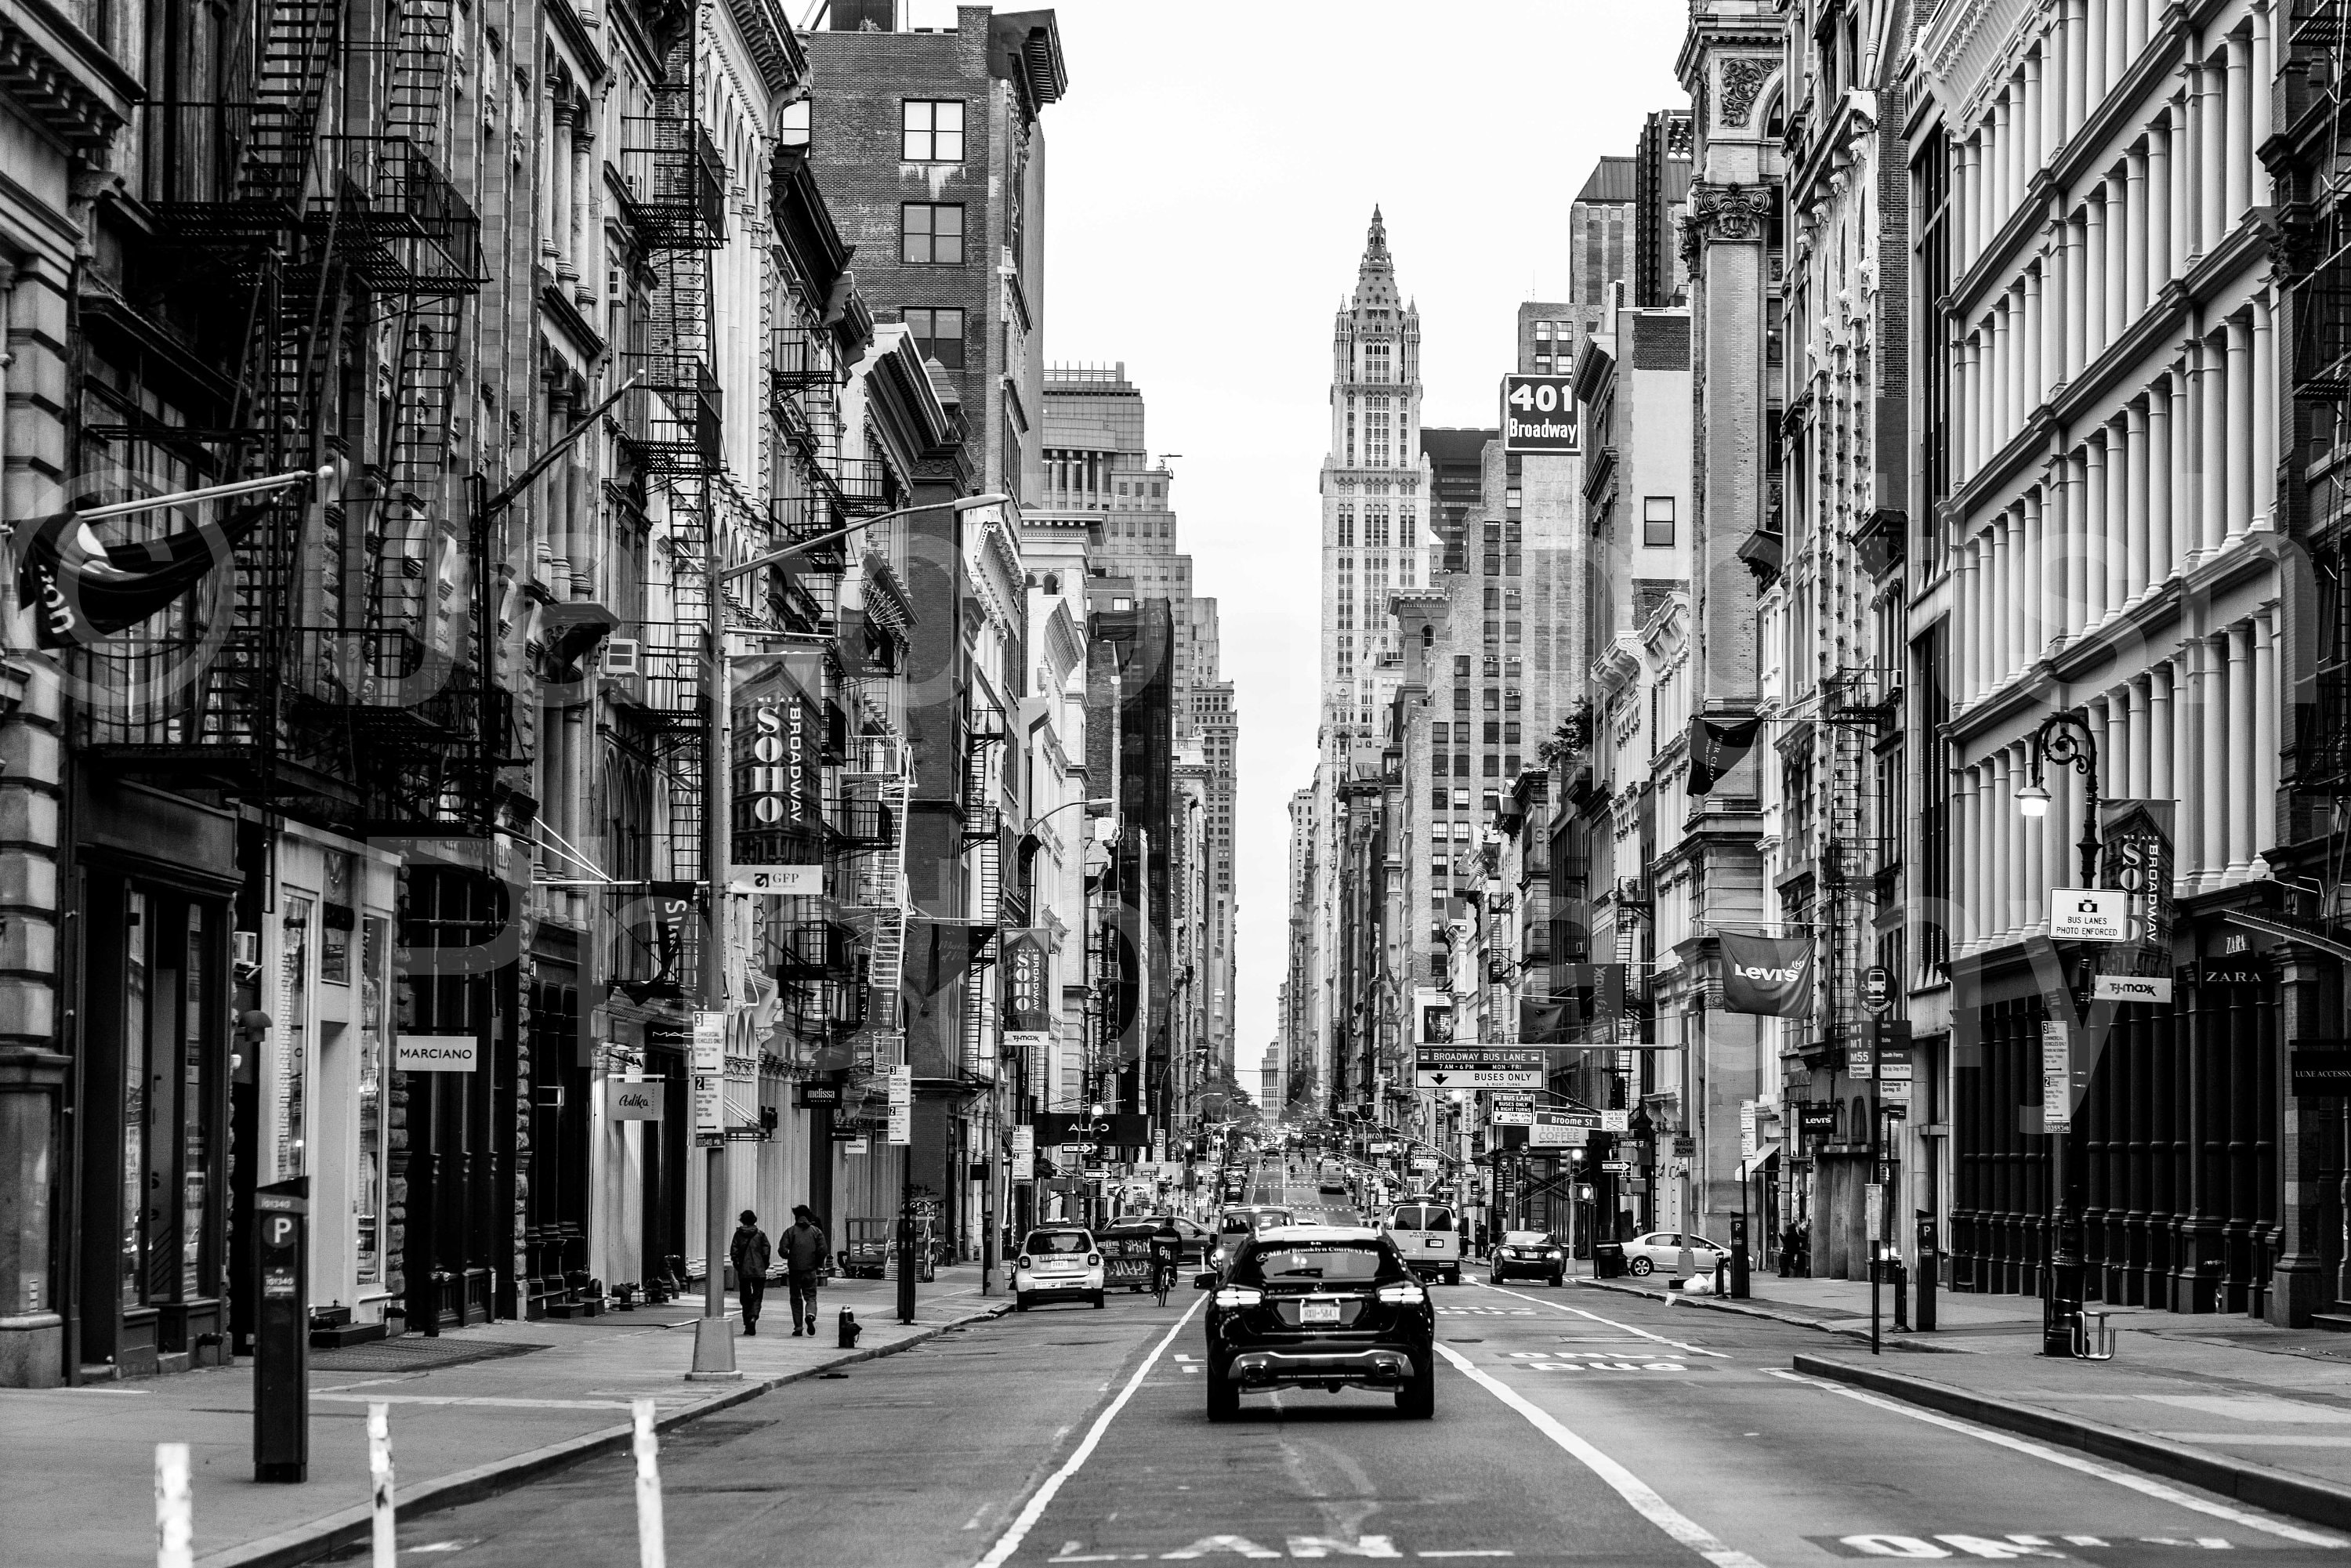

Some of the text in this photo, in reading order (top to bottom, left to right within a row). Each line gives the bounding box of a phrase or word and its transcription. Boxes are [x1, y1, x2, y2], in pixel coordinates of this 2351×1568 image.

[1509, 383, 1572, 412] 401
[1509, 418, 1578, 444] Broadway
[752, 706, 785, 823] SOHO
[789, 707, 802, 822] BROADWAY
[773, 873, 799, 884] GFP
[2147, 844, 2159, 941] BROADWAY
[2067, 916, 2107, 925] BUS LANES
[2056, 926, 2117, 936] PHOTO ENFORCED
[1016, 953, 1031, 1011] SOHO
[2206, 972, 2262, 982] ZARA
[1860, 1000, 1892, 1012] NO STANDING
[695, 1014, 702, 1027] 3
[1850, 1023, 1862, 1034] M1
[2043, 1023, 2049, 1034] 3
[1850, 1037, 1862, 1048] M1
[400, 1048, 472, 1059] MARCIANO
[1433, 1052, 1527, 1062] BROADWAY BUS LANE
[1850, 1052, 1869, 1063] M55
[890, 1066, 896, 1075] 3
[1474, 1073, 1505, 1081] BUSES
[2045, 1077, 2050, 1087] 2
[696, 1077, 703, 1090] 2
[807, 1088, 835, 1099] melissa
[618, 1094, 650, 1110] Adika
[890, 1107, 895, 1116] 2
[1552, 1115, 1593, 1126] Broome St
[1067, 1123, 1110, 1132] ALO
[1538, 1132, 1580, 1140] COFFEE
[274, 1218, 292, 1244] P
[1735, 1222, 1741, 1231] P
[1924, 1226, 1931, 1237] P
[1328, 1246, 1363, 1255] Courtesy
